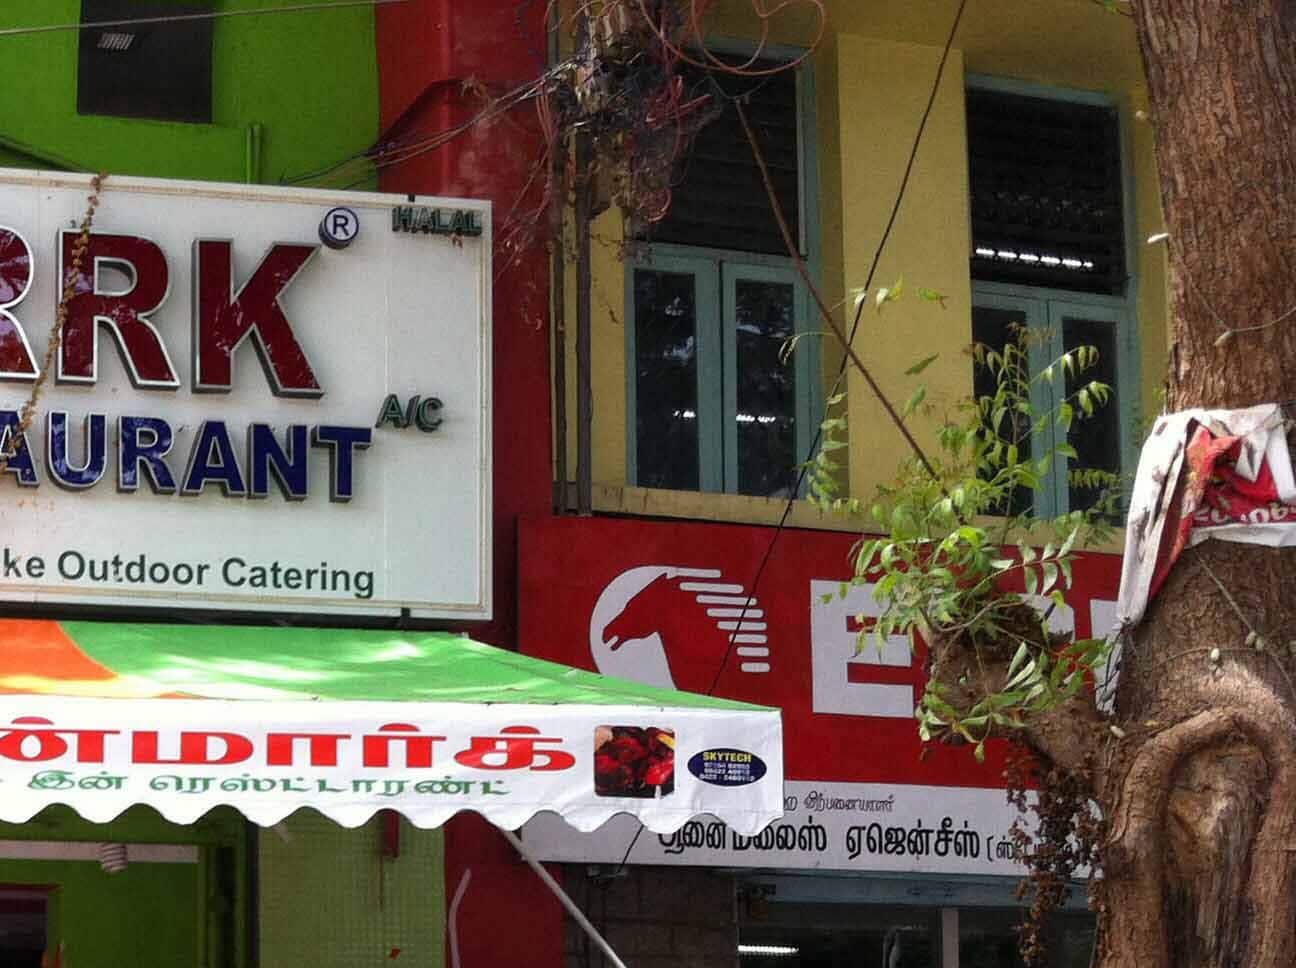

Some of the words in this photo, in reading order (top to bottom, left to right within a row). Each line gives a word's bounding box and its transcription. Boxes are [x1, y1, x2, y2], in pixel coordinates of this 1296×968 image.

[392, 206, 482, 237] HALAL
[376, 393, 446, 432] A/C
[57, 550, 210, 588] Outdoor
[222, 556, 376, 599] Catering
[702, 751, 753, 763] SKYTECH
